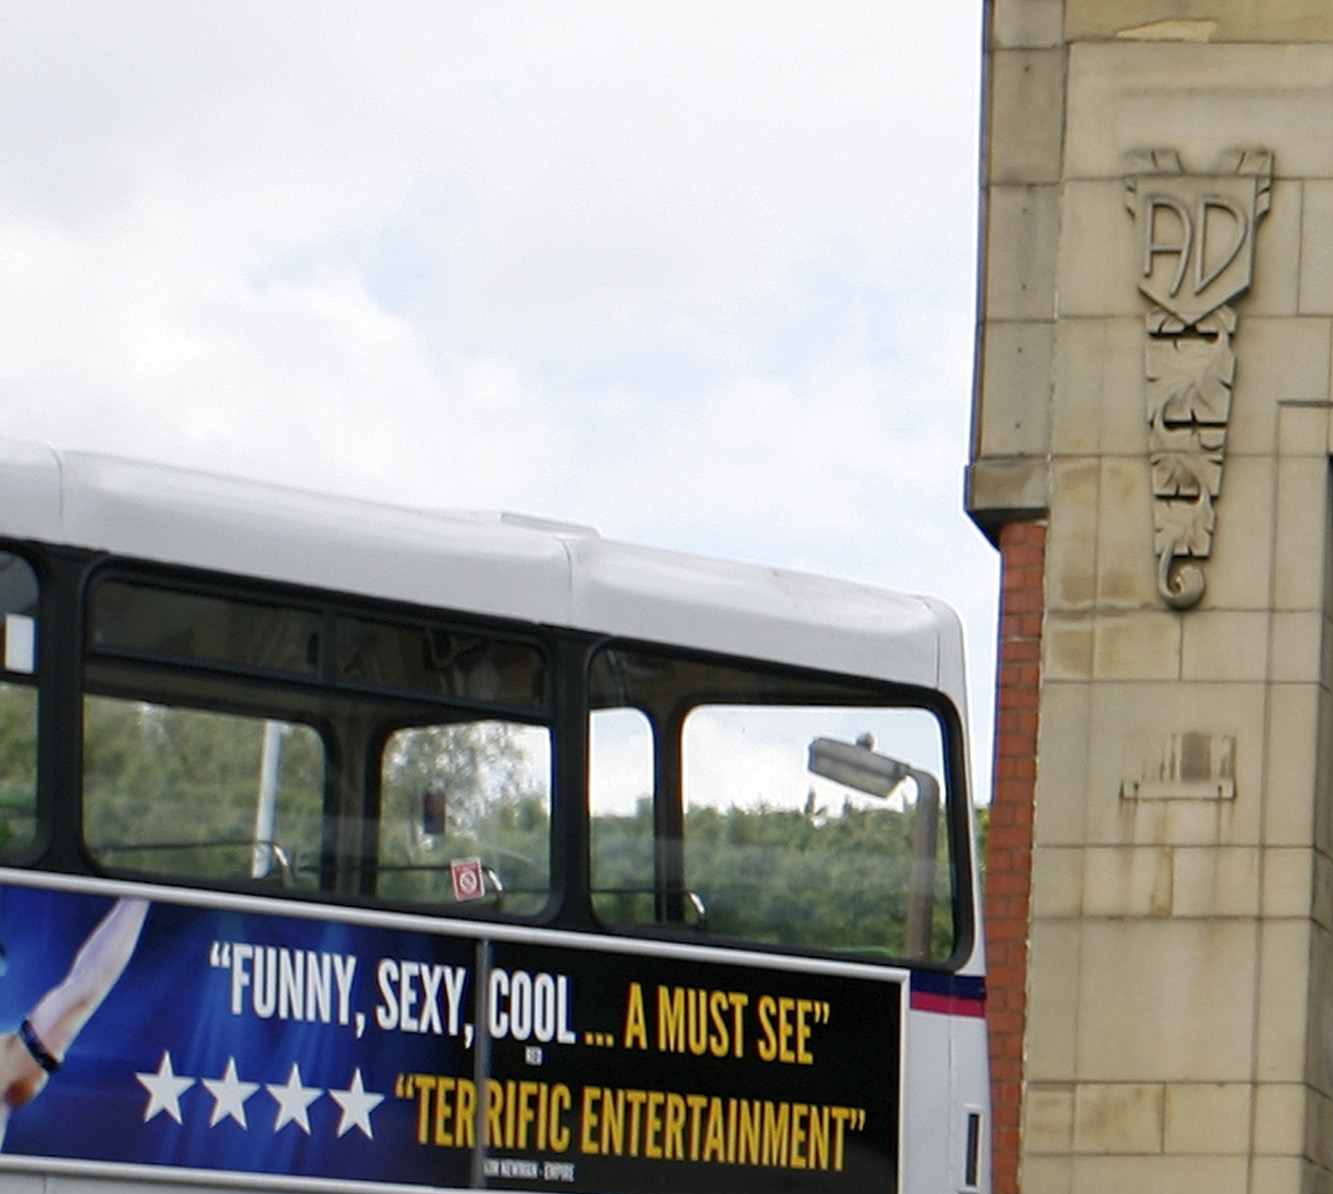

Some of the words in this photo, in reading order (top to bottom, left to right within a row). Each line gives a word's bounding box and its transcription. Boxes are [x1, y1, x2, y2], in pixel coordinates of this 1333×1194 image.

[376, 957, 474, 1049] SEXY,
[488, 967, 576, 1045] COOL
[623, 981, 648, 1050] A
[657, 984, 749, 1059] MUST
